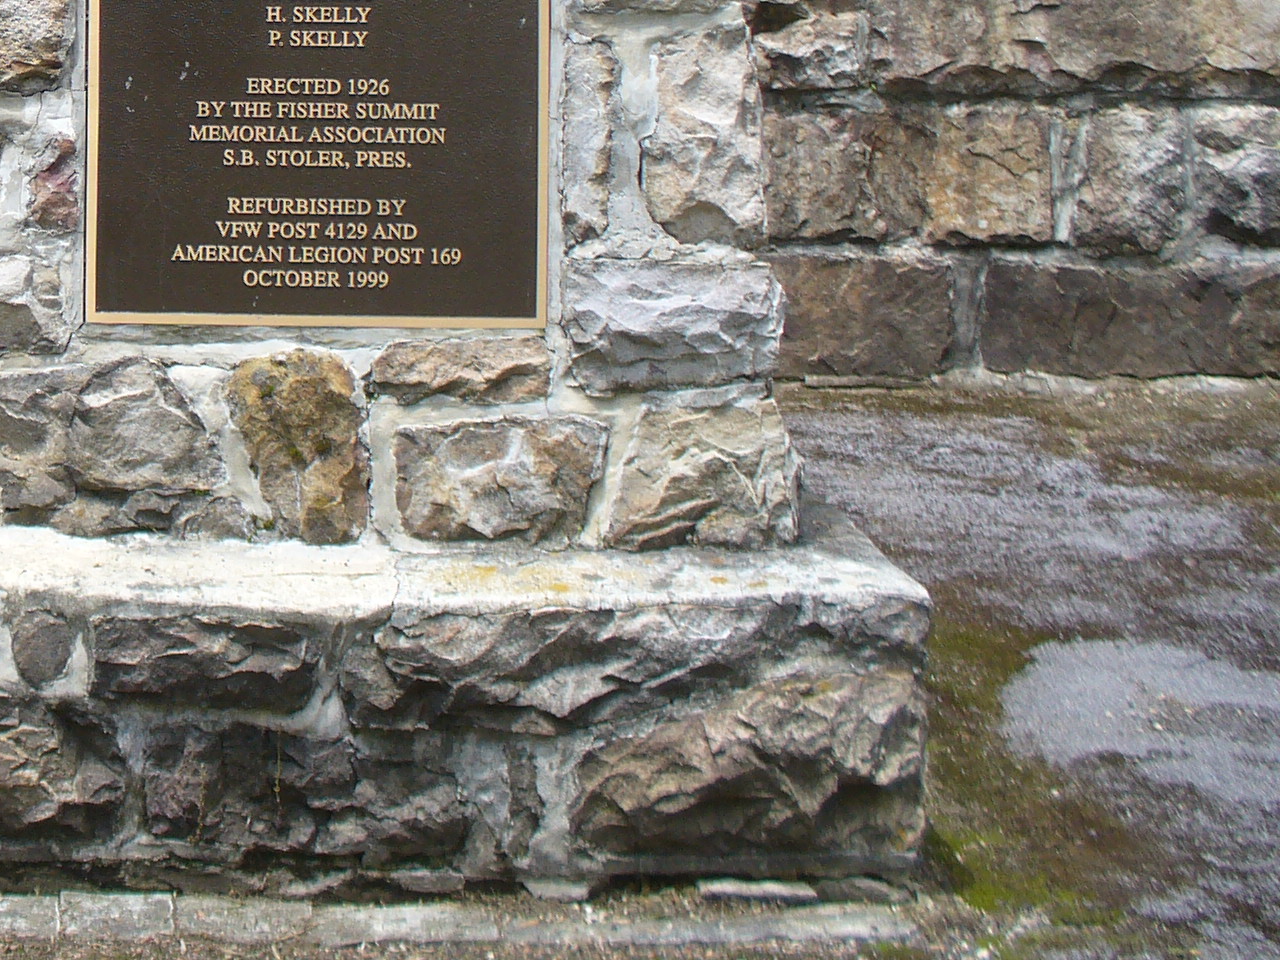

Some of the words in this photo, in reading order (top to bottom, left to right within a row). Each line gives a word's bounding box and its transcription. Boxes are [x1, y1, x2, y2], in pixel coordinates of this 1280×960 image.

[265, 5, 287, 23] H.
[292, 6, 372, 24] SKELLY
[267, 29, 284, 47] P.
[288, 29, 369, 47] SKELLY
[245, 77, 342, 95] ERECTED
[348, 78, 390, 96] 1926
[195, 100, 226, 118] BY
[230, 101, 273, 118] THE
[276, 101, 351, 119] FISHER
[354, 102, 440, 120] SUMMIT
[188, 124, 304, 143] MEMORIAL
[307, 125, 447, 144] ASSOCIATION
[222, 148, 260, 166] S.B.
[265, 149, 351, 170] STOLER,
[354, 150, 412, 168] PRES.
[227, 196, 372, 216] REFURBISHED
[376, 199, 407, 216] BY
[215, 220, 263, 239] VFW
[267, 221, 321, 239] POST
[324, 222, 368, 240] 4129
[371, 222, 418, 240] AND
[170, 243, 284, 263] AMERICAN
[287, 245, 368, 264] LEGION
[371, 246, 425, 265] POST
[431, 247, 462, 265] 169
[242, 269, 342, 288] OCTOBER
[347, 270, 389, 289] 1999
